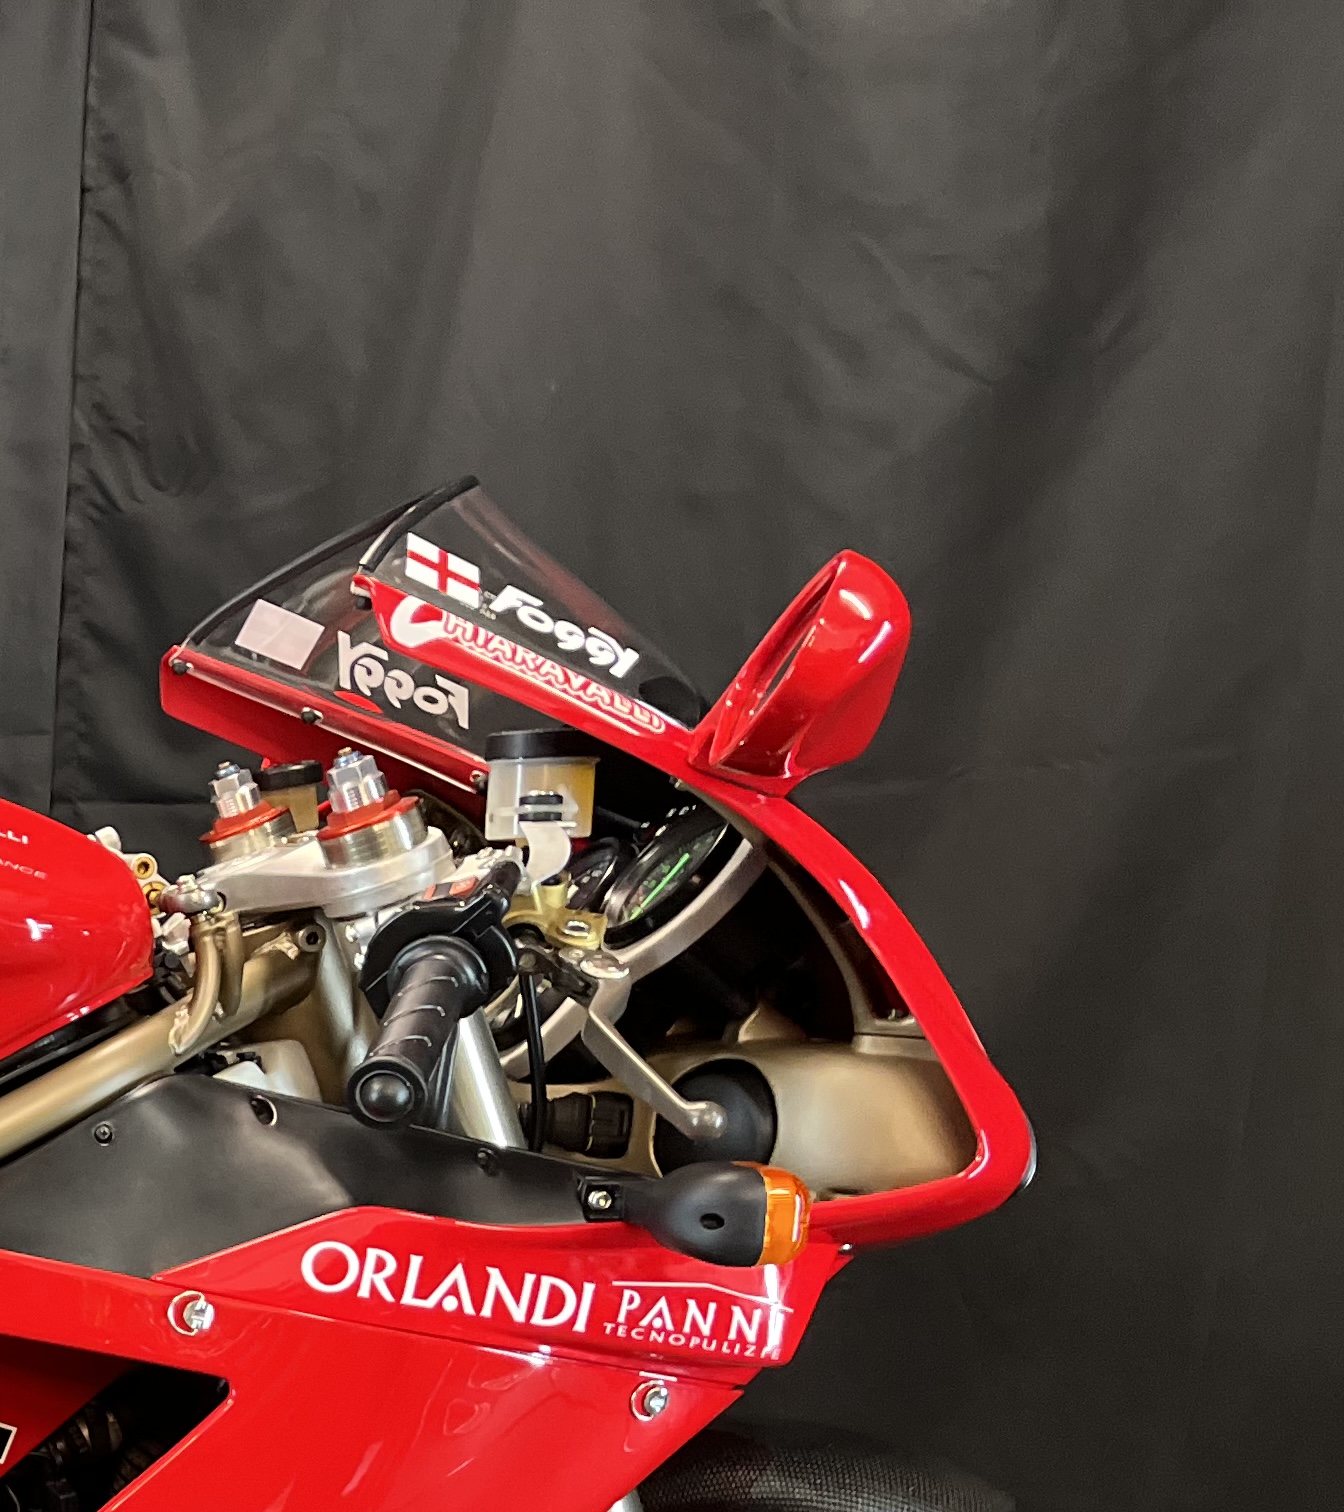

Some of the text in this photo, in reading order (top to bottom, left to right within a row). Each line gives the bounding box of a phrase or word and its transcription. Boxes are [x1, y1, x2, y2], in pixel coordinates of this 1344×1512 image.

[489, 584, 640, 678] Foggy
[301, 1241, 597, 1333] ORLANDI
[616, 1288, 785, 1352] PANNI
